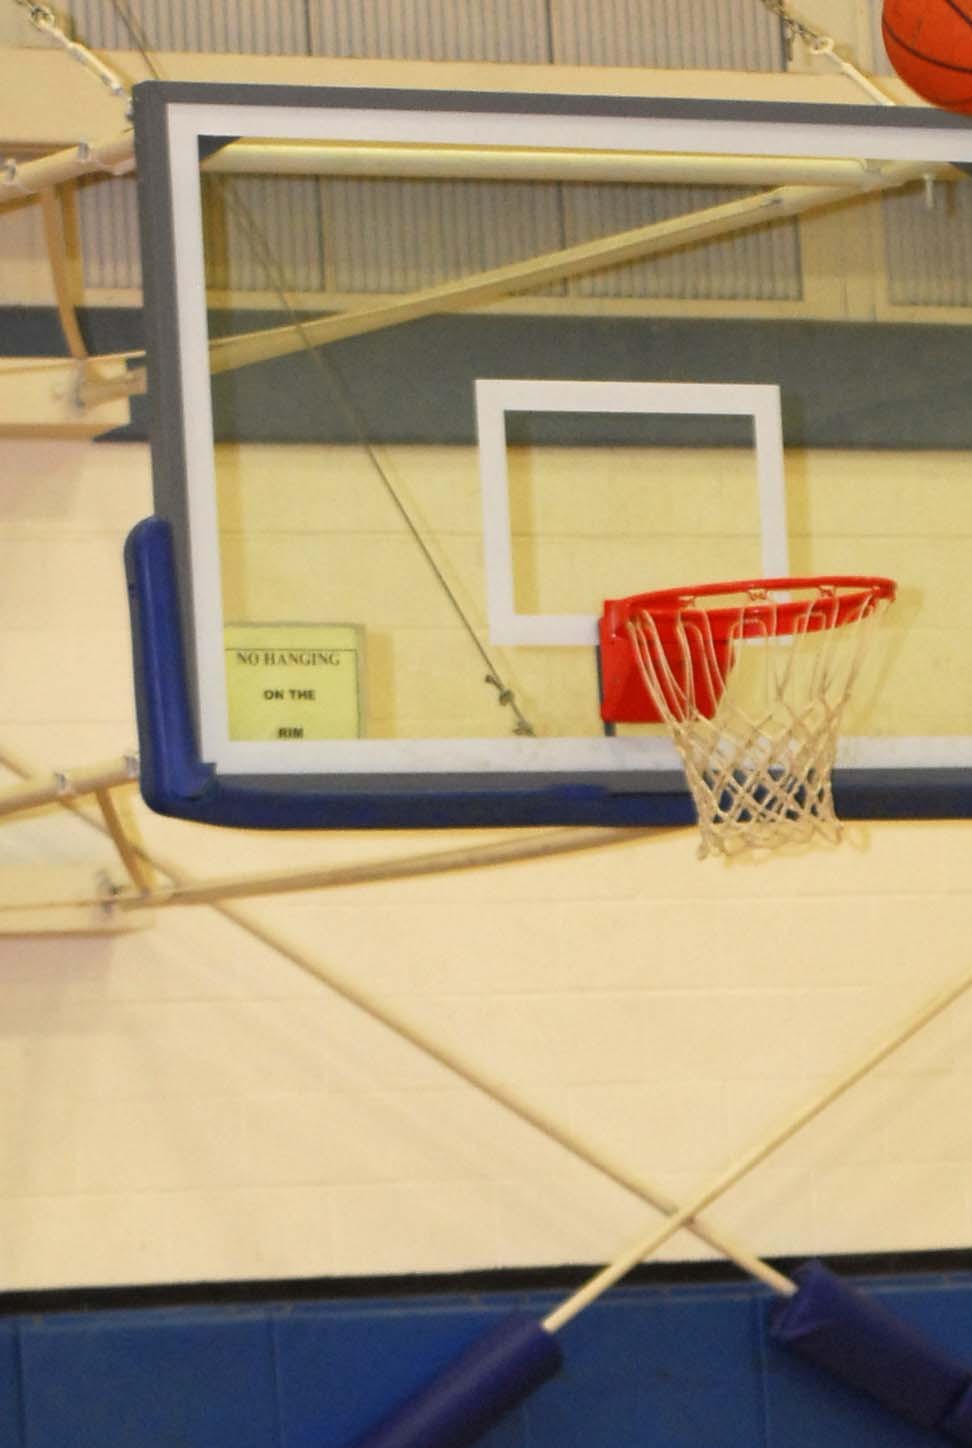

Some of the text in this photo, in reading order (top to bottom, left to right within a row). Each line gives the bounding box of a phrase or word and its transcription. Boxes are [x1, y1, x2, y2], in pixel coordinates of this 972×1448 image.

[236, 652, 340, 666] NO HANGING
[264, 689, 316, 700] ON THE
[278, 728, 304, 739] RIM
